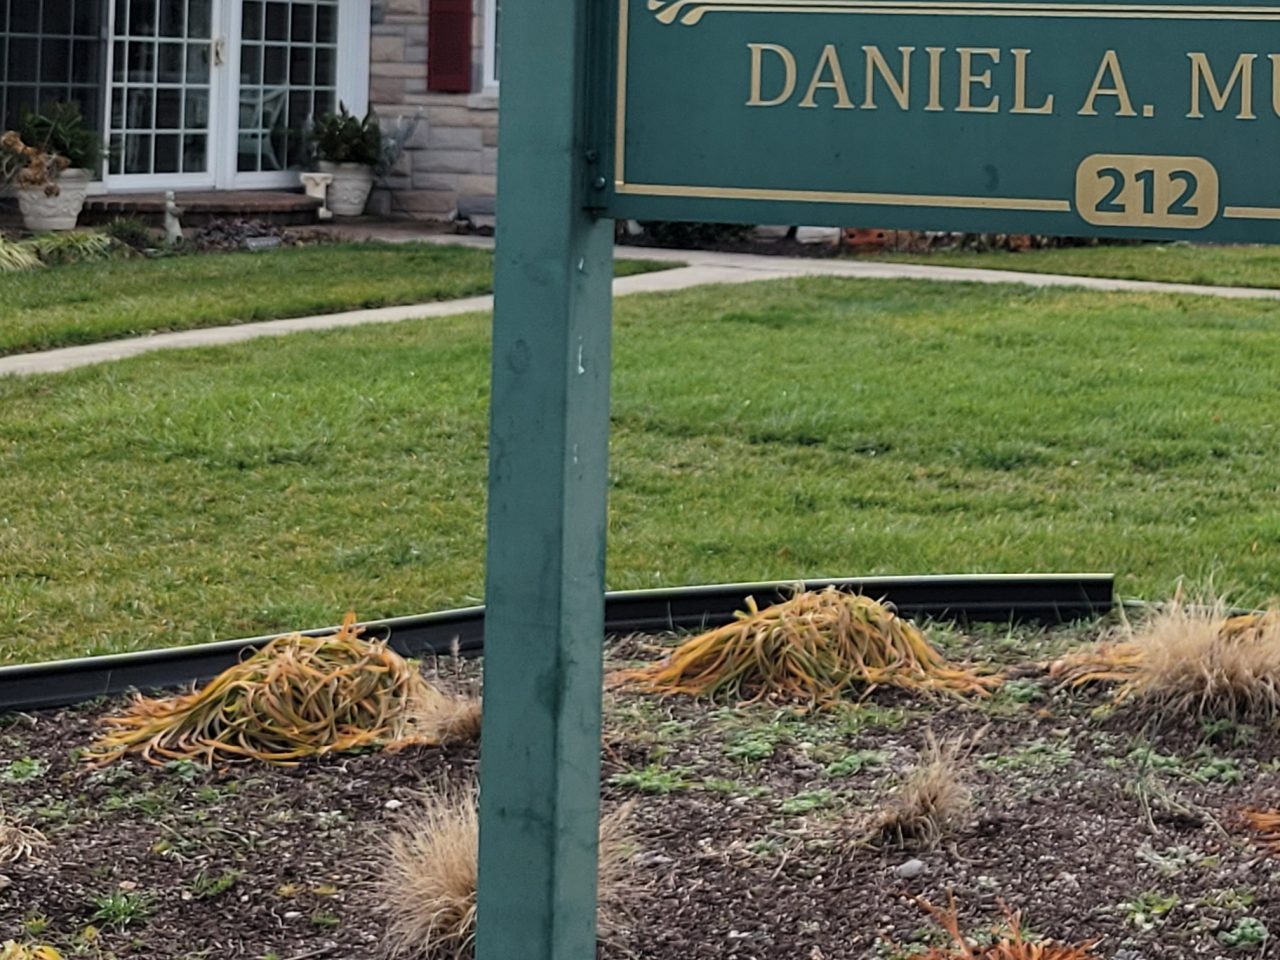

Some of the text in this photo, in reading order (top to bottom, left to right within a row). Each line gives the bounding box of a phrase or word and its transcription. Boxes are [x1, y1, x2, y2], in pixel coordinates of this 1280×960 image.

[745, 43, 1054, 114] DANIEL
[1077, 50, 1154, 117] A.
[1095, 168, 1198, 215] 212
